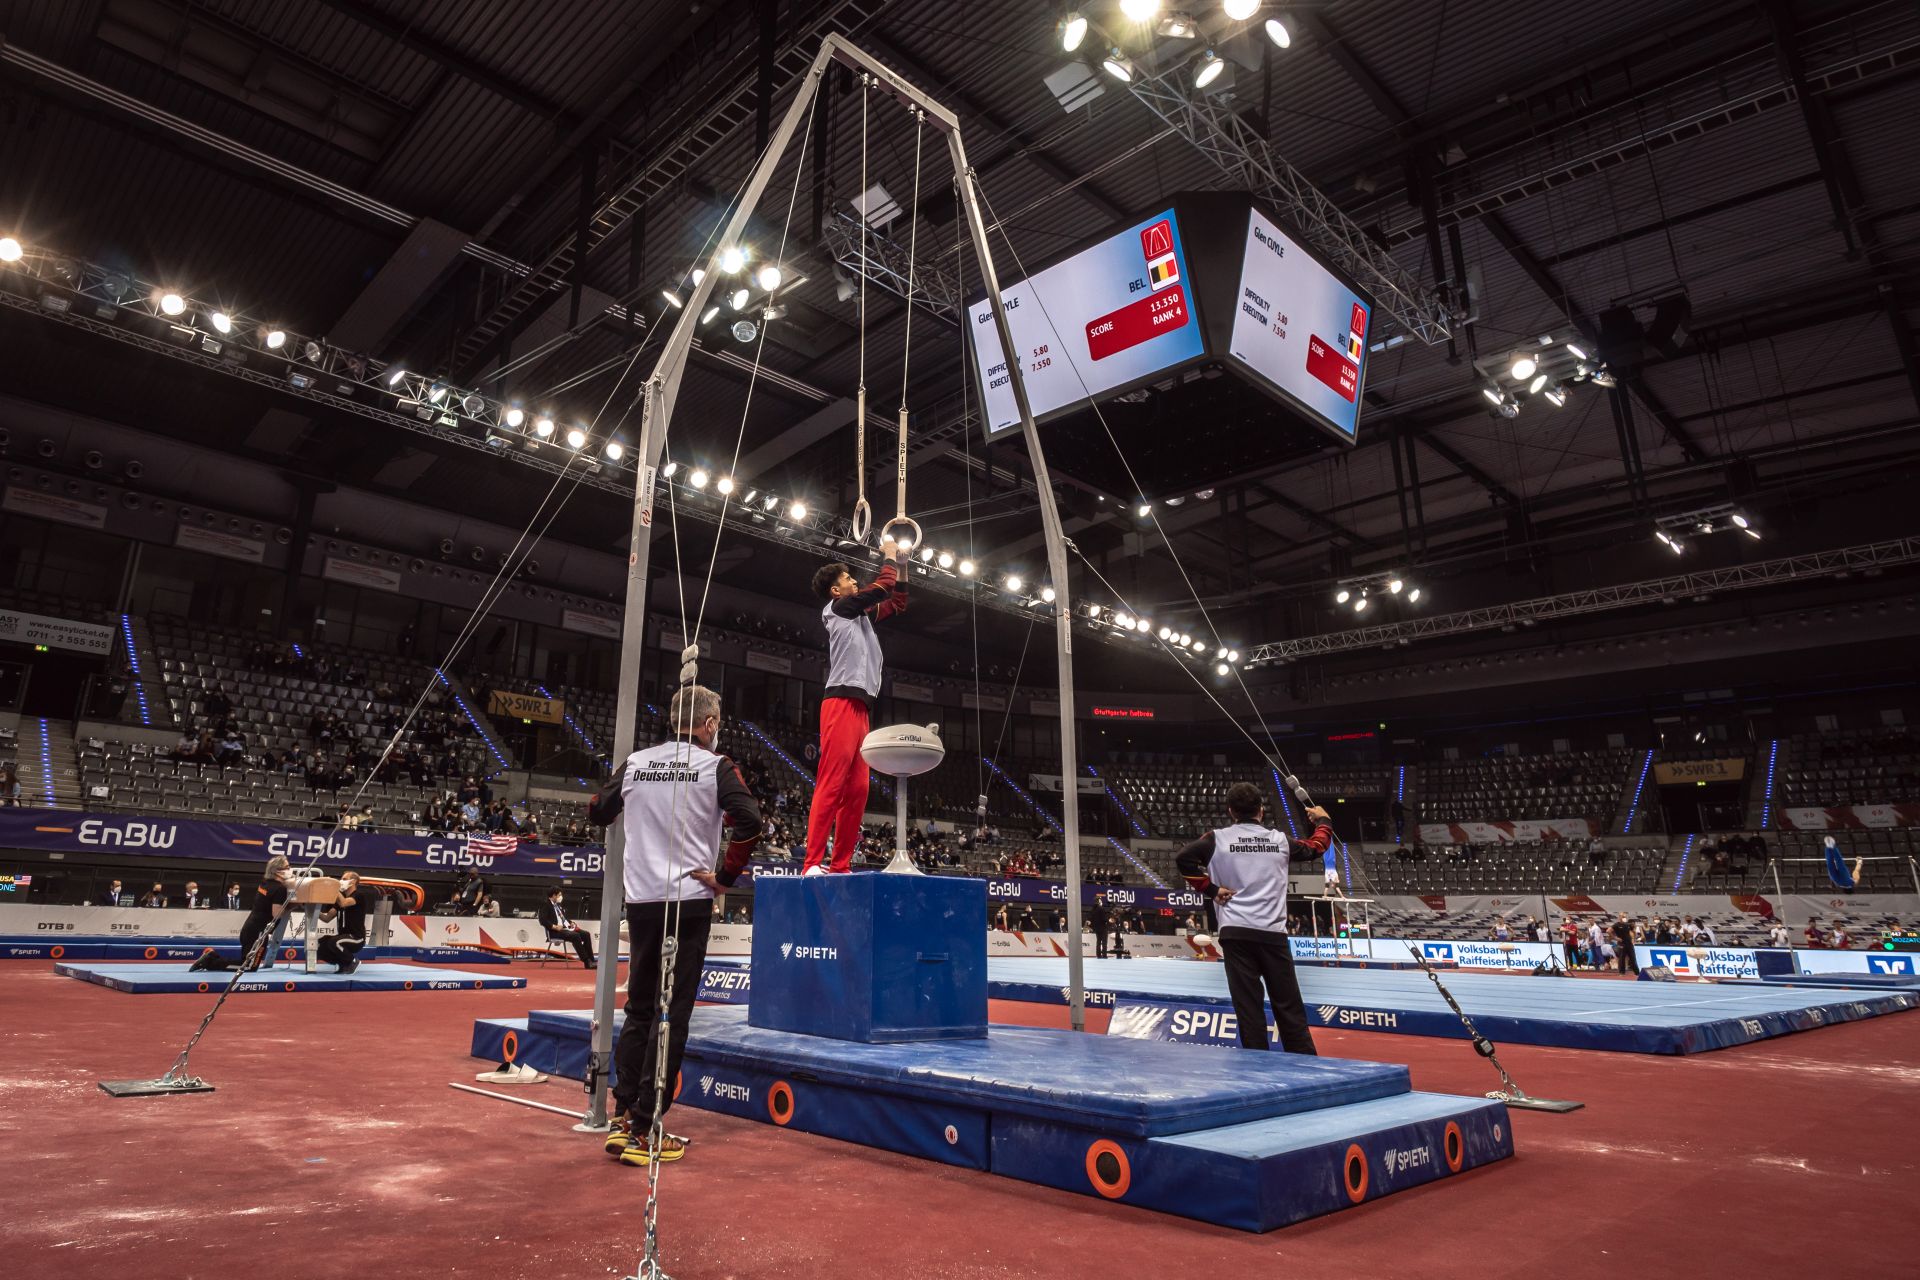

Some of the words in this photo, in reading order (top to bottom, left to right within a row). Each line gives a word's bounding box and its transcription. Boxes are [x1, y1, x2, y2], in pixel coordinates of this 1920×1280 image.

[1254, 226, 1267, 244] Glen
[1267, 237, 1285, 258] CUYLE
[1129, 278, 1147, 293] BEL
[1150, 293, 1179, 312] 13.350
[1245, 287, 1271, 312] DIFFICULTY
[1152, 310, 1174, 325] RANK
[1175, 307, 1182, 316] 4
[1243, 302, 1268, 326] EXECUTION
[1090, 321, 1114, 338] SCORE
[1033, 344, 1049, 358] 5.80
[1311, 341, 1325, 358] SCORE
[1032, 357, 1051, 372] 7.550
[29, 621, 110, 638] www.easyticket.de
[27, 630, 48, 640] 0711
[67, 636, 86, 646] 555
[89, 640, 107, 649] 555
[648, 760, 689, 769] Turn-Team
[633, 770, 699, 782] Deutschland
[78, 820, 177, 849] EnBW
[267, 833, 350, 859] EnBW
[1230, 844, 1280, 853] Deutschland
[426, 843, 494, 868] EnBW
[560, 852, 606, 873] EnB
[989, 881, 1021, 897] EnBW
[1106, 889, 1135, 903] EnBW
[1168, 893, 1204, 906] EnBW
[37, 922, 64, 930] DTB
[795, 946, 837, 960] SPIETH
[1457, 944, 1522, 955] Volksbanen
[239, 983, 268, 991] SPIETH
[705, 970, 750, 990] SPIETH
[699, 988, 731, 999] Gymnastics
[1083, 991, 1116, 1005] PIETH
[1170, 1009, 1280, 1043] SPIEH
[1339, 1009, 1397, 1027] SPIETH
[714, 1081, 750, 1102] SPIETH
[1397, 1146, 1430, 1171] SPIETH
